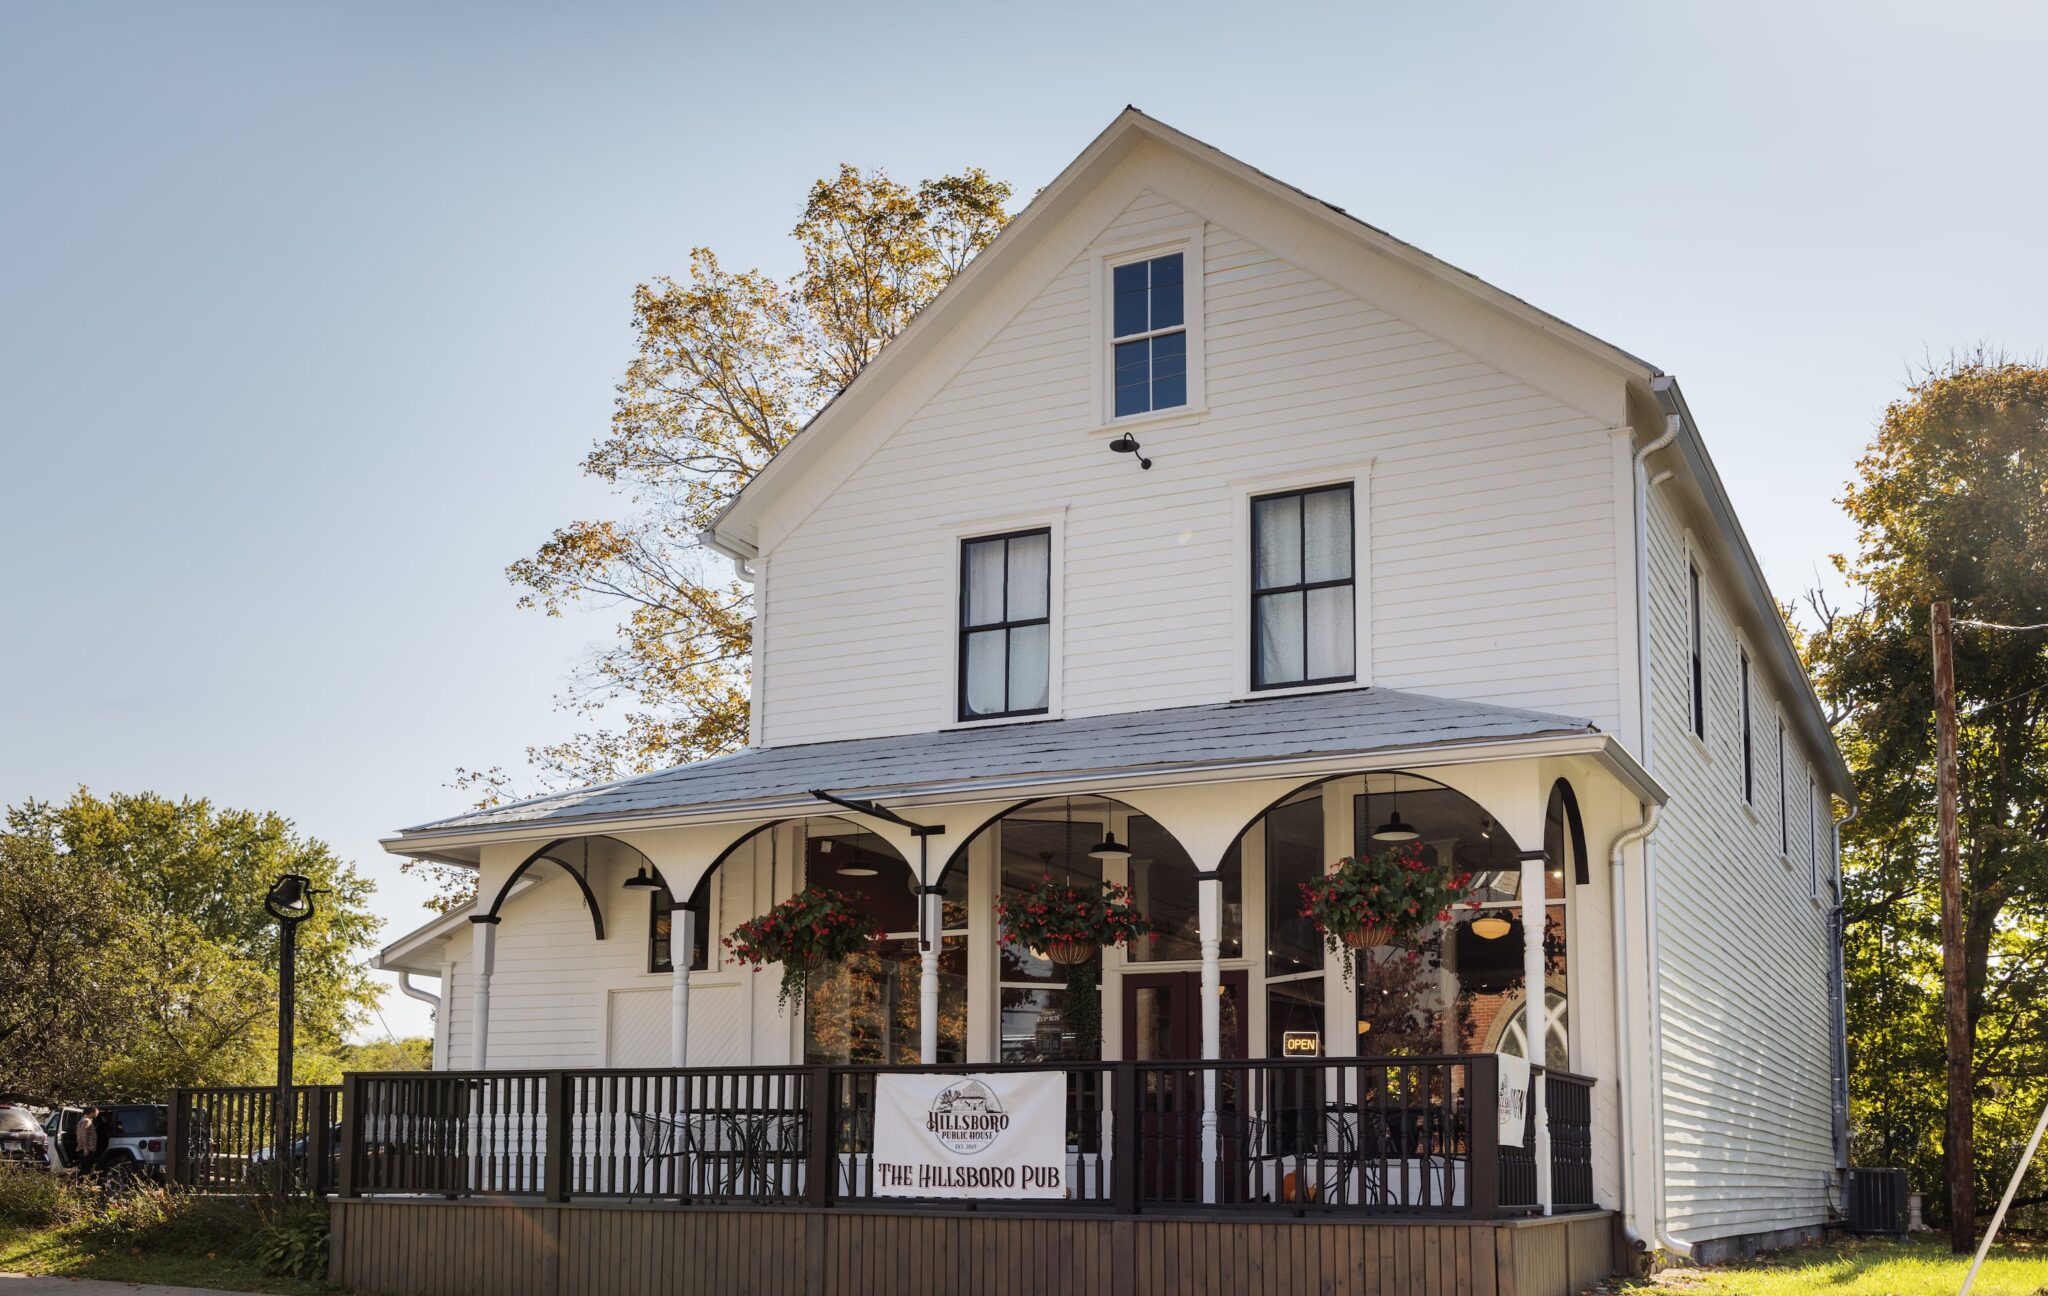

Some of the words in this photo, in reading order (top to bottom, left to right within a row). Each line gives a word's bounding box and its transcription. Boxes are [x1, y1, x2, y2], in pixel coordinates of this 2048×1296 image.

[1037, 1014, 1061, 1022] OPEN
[1288, 1039, 1315, 1050] OPEN
[926, 1111, 1009, 1133] HILLSBORO
[941, 1131, 967, 1140] PUBLIC
[969, 1131, 993, 1140] HOUSE
[878, 1163, 913, 1187] THE
[919, 1164, 1015, 1189] HILLSBORO
[1021, 1165, 1060, 1190] PUB
